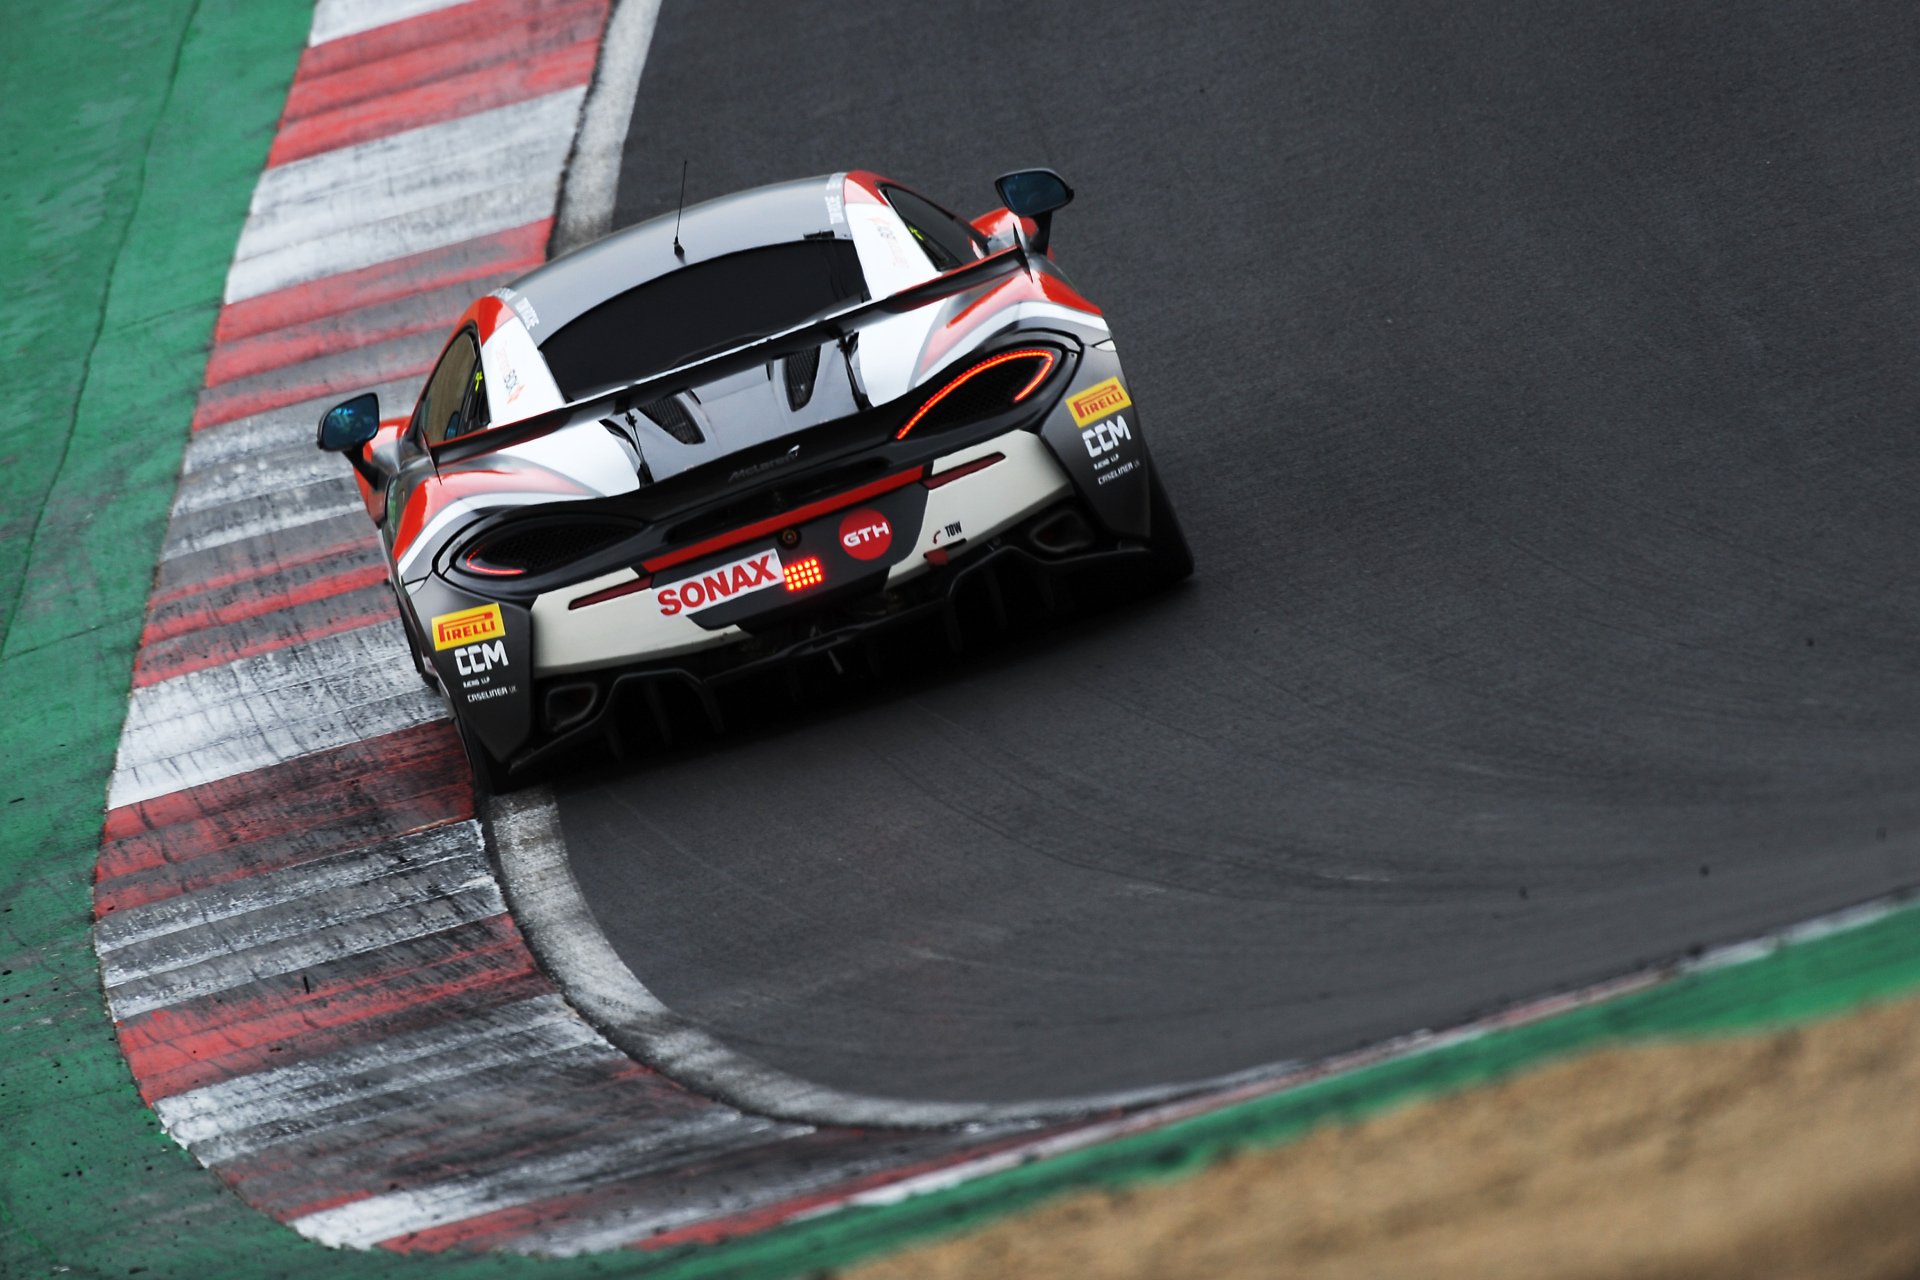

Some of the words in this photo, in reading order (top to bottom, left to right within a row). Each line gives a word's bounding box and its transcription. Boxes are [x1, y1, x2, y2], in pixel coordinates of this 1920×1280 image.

[1073, 384, 1123, 418] PIRELLI
[1082, 415, 1132, 458] CCM
[843, 521, 890, 547] GTH
[945, 521, 962, 538] TOW
[657, 555, 777, 616] SONAX
[438, 612, 496, 643] PIRELLI
[454, 640, 509, 676] CCM
